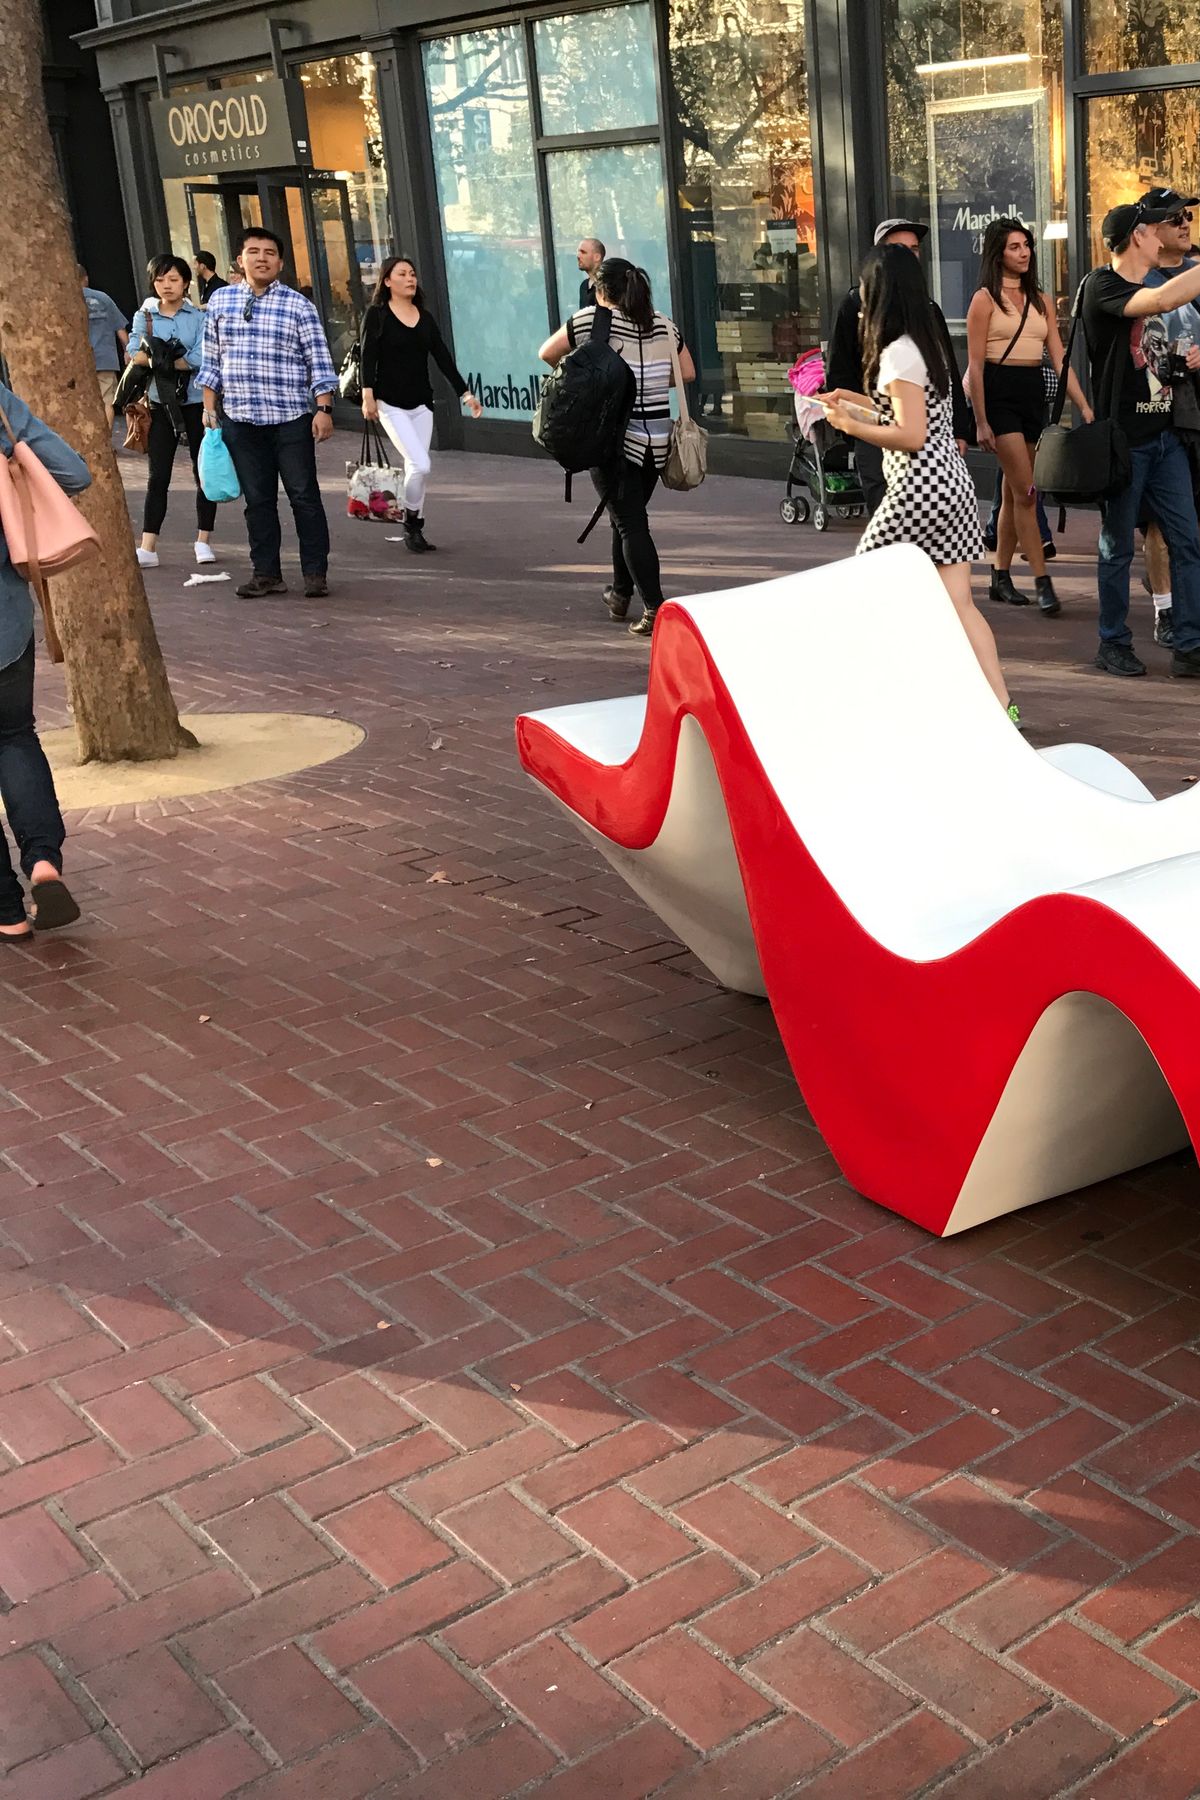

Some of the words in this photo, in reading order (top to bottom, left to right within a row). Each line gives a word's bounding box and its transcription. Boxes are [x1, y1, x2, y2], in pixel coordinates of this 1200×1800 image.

[168, 94, 268, 147] OROGOLD
[185, 145, 261, 166] cosmetics
[463, 372, 541, 411] Marshall
